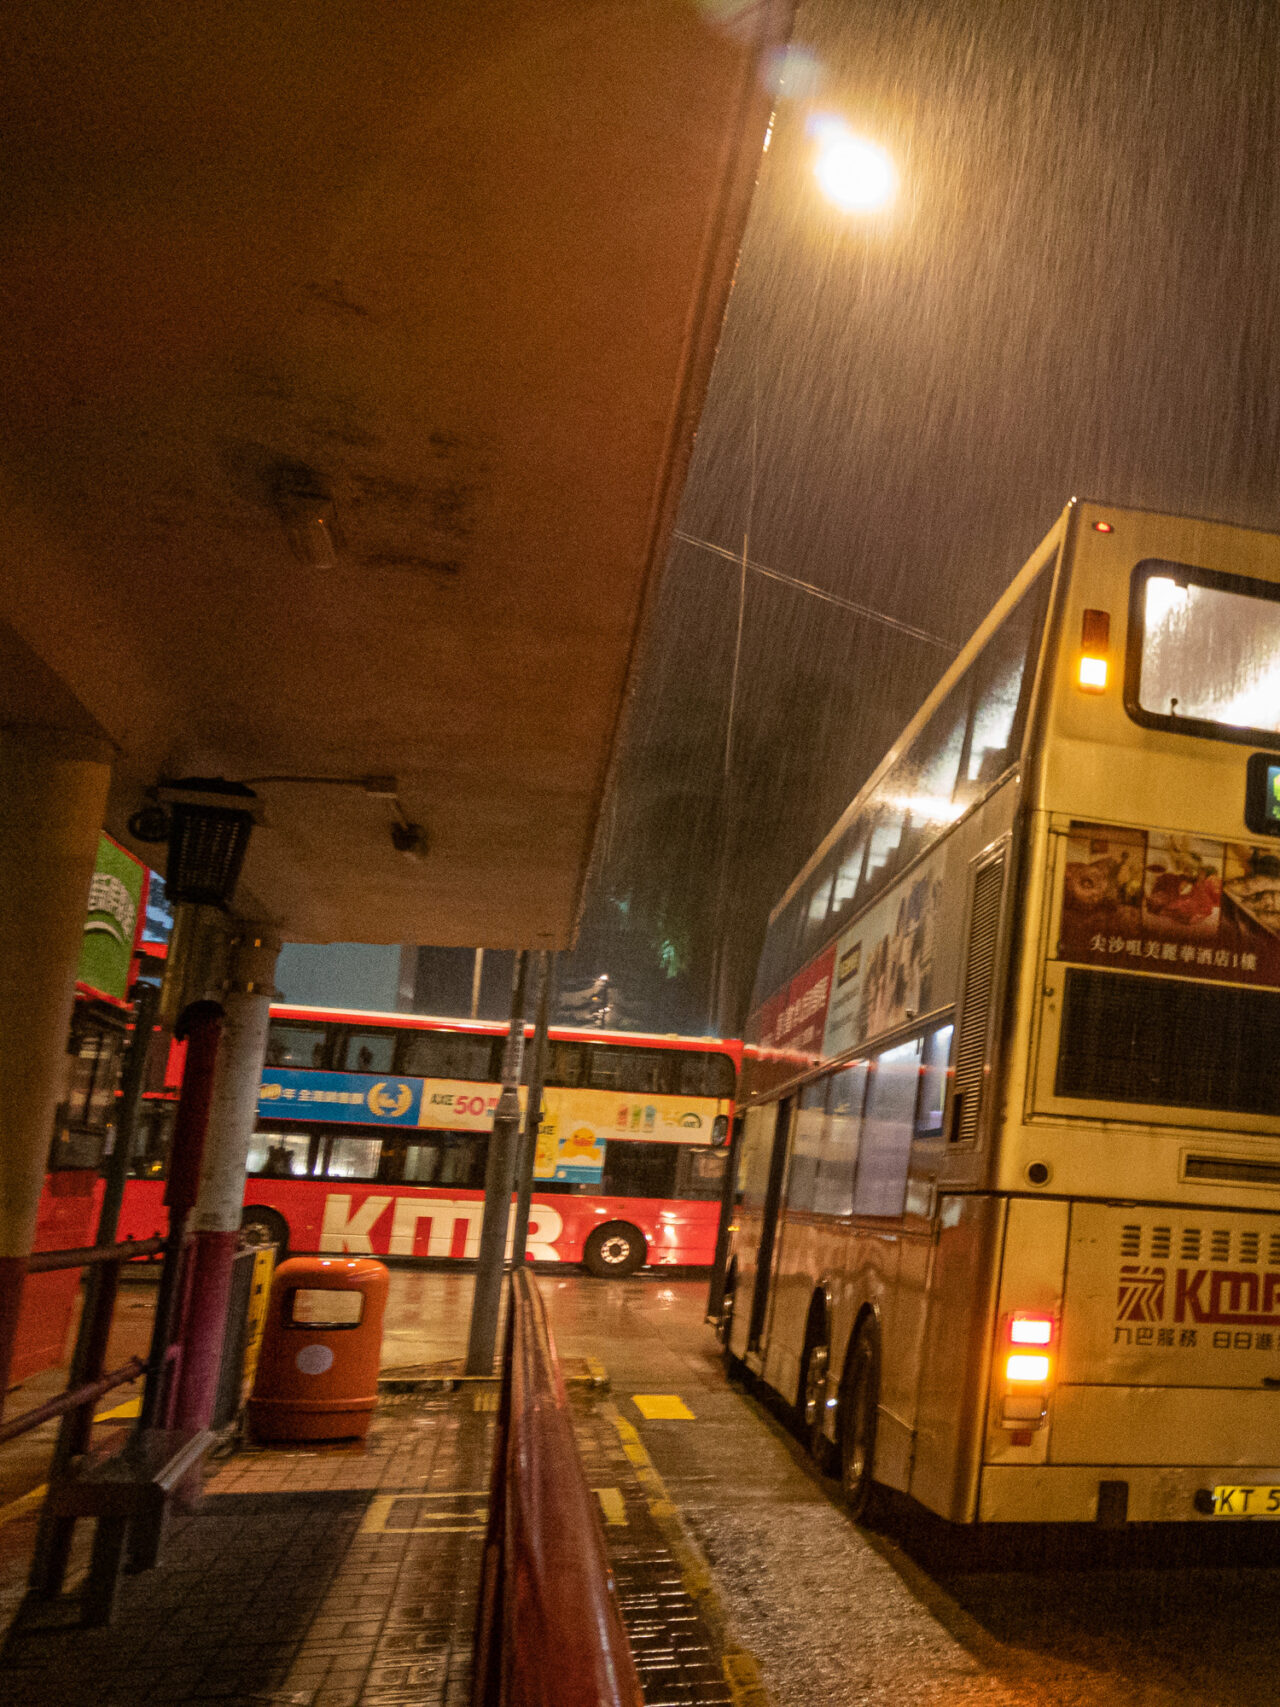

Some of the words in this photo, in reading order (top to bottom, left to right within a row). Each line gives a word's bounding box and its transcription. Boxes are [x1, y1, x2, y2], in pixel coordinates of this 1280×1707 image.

[453, 1095, 486, 1116] 50
[1113, 1326, 1199, 1349] 九巴服務
[1218, 1488, 1255, 1513] KT
